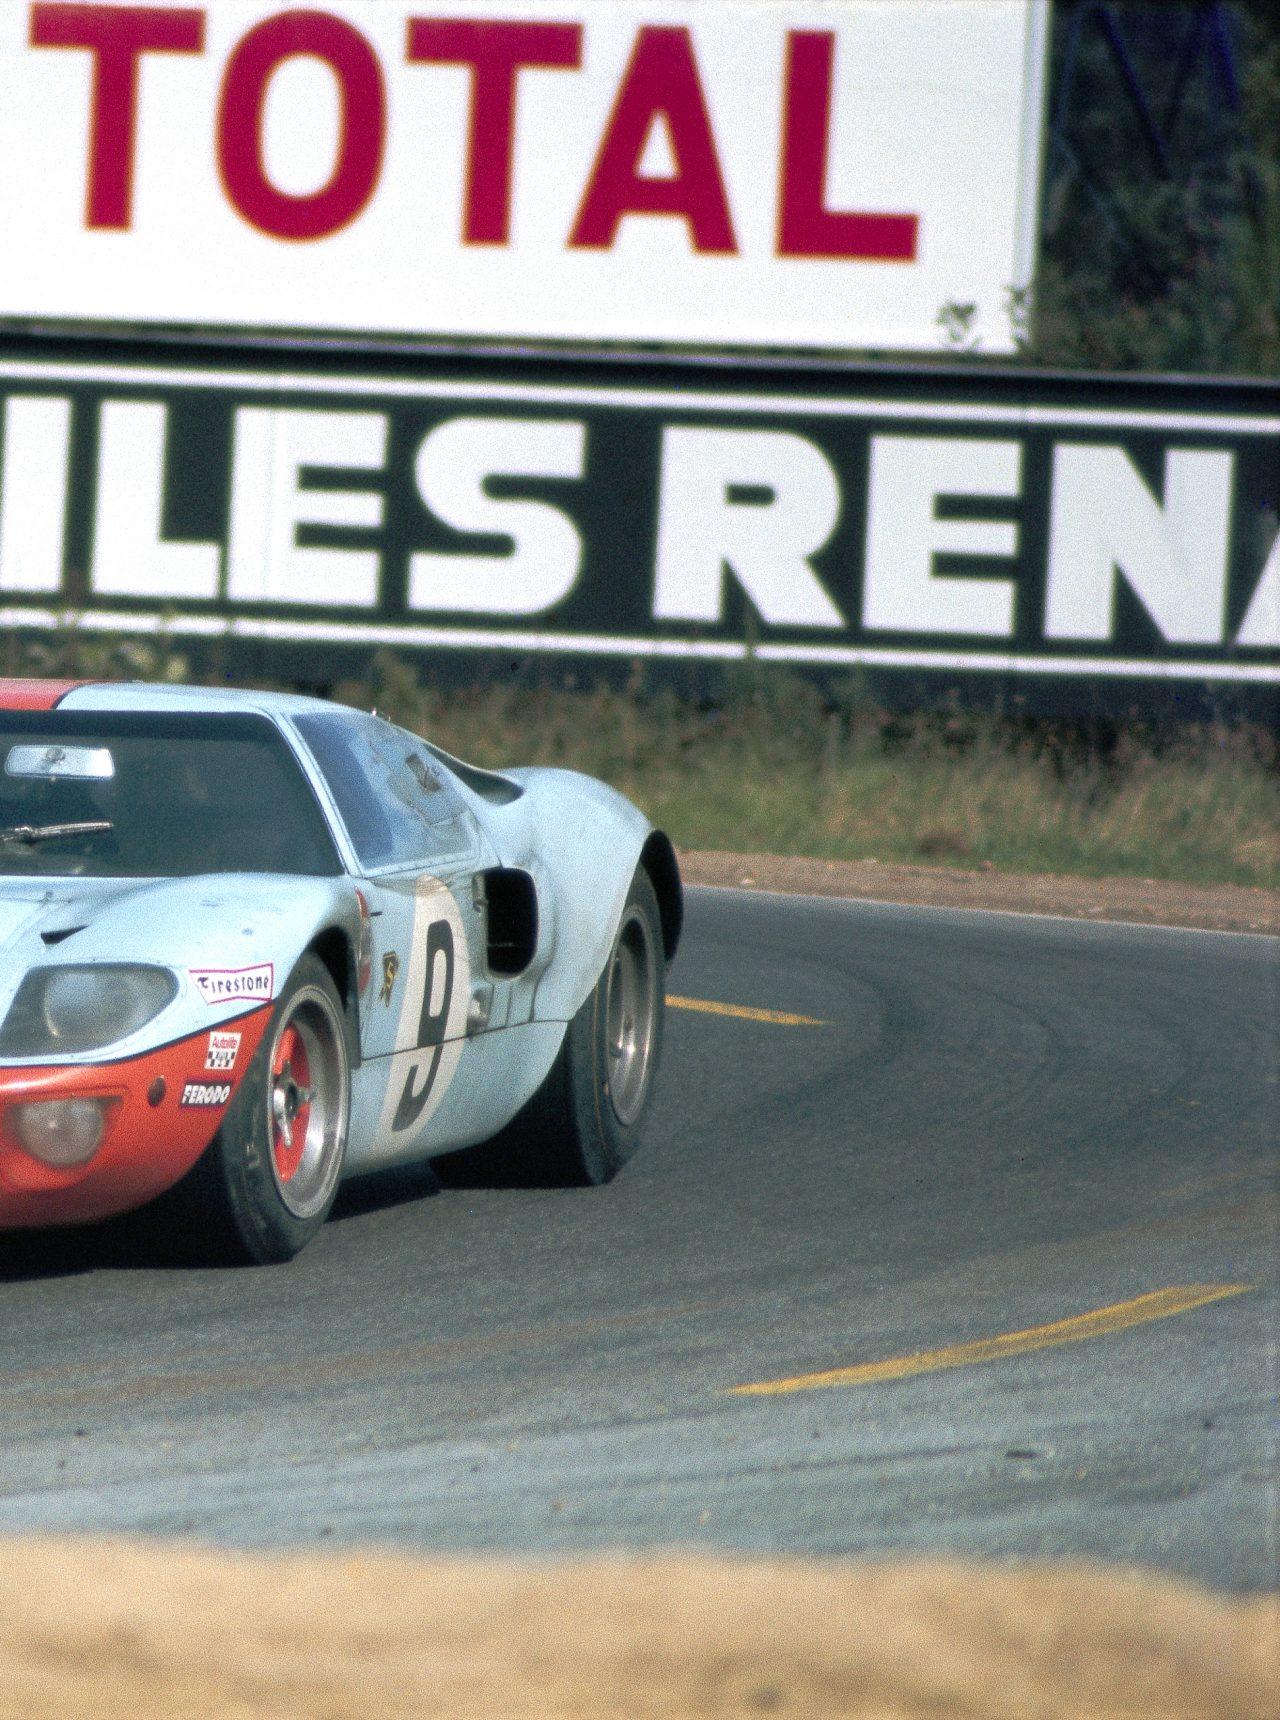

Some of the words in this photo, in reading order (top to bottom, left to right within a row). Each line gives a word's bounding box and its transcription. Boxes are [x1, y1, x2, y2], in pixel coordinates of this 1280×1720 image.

[30, 2, 919, 262] TOTAL
[651, 424, 1280, 648] REN
[197, 976, 269, 995] Firestone
[391, 918, 455, 1132] 9
[182, 1084, 231, 1104] FERODO
